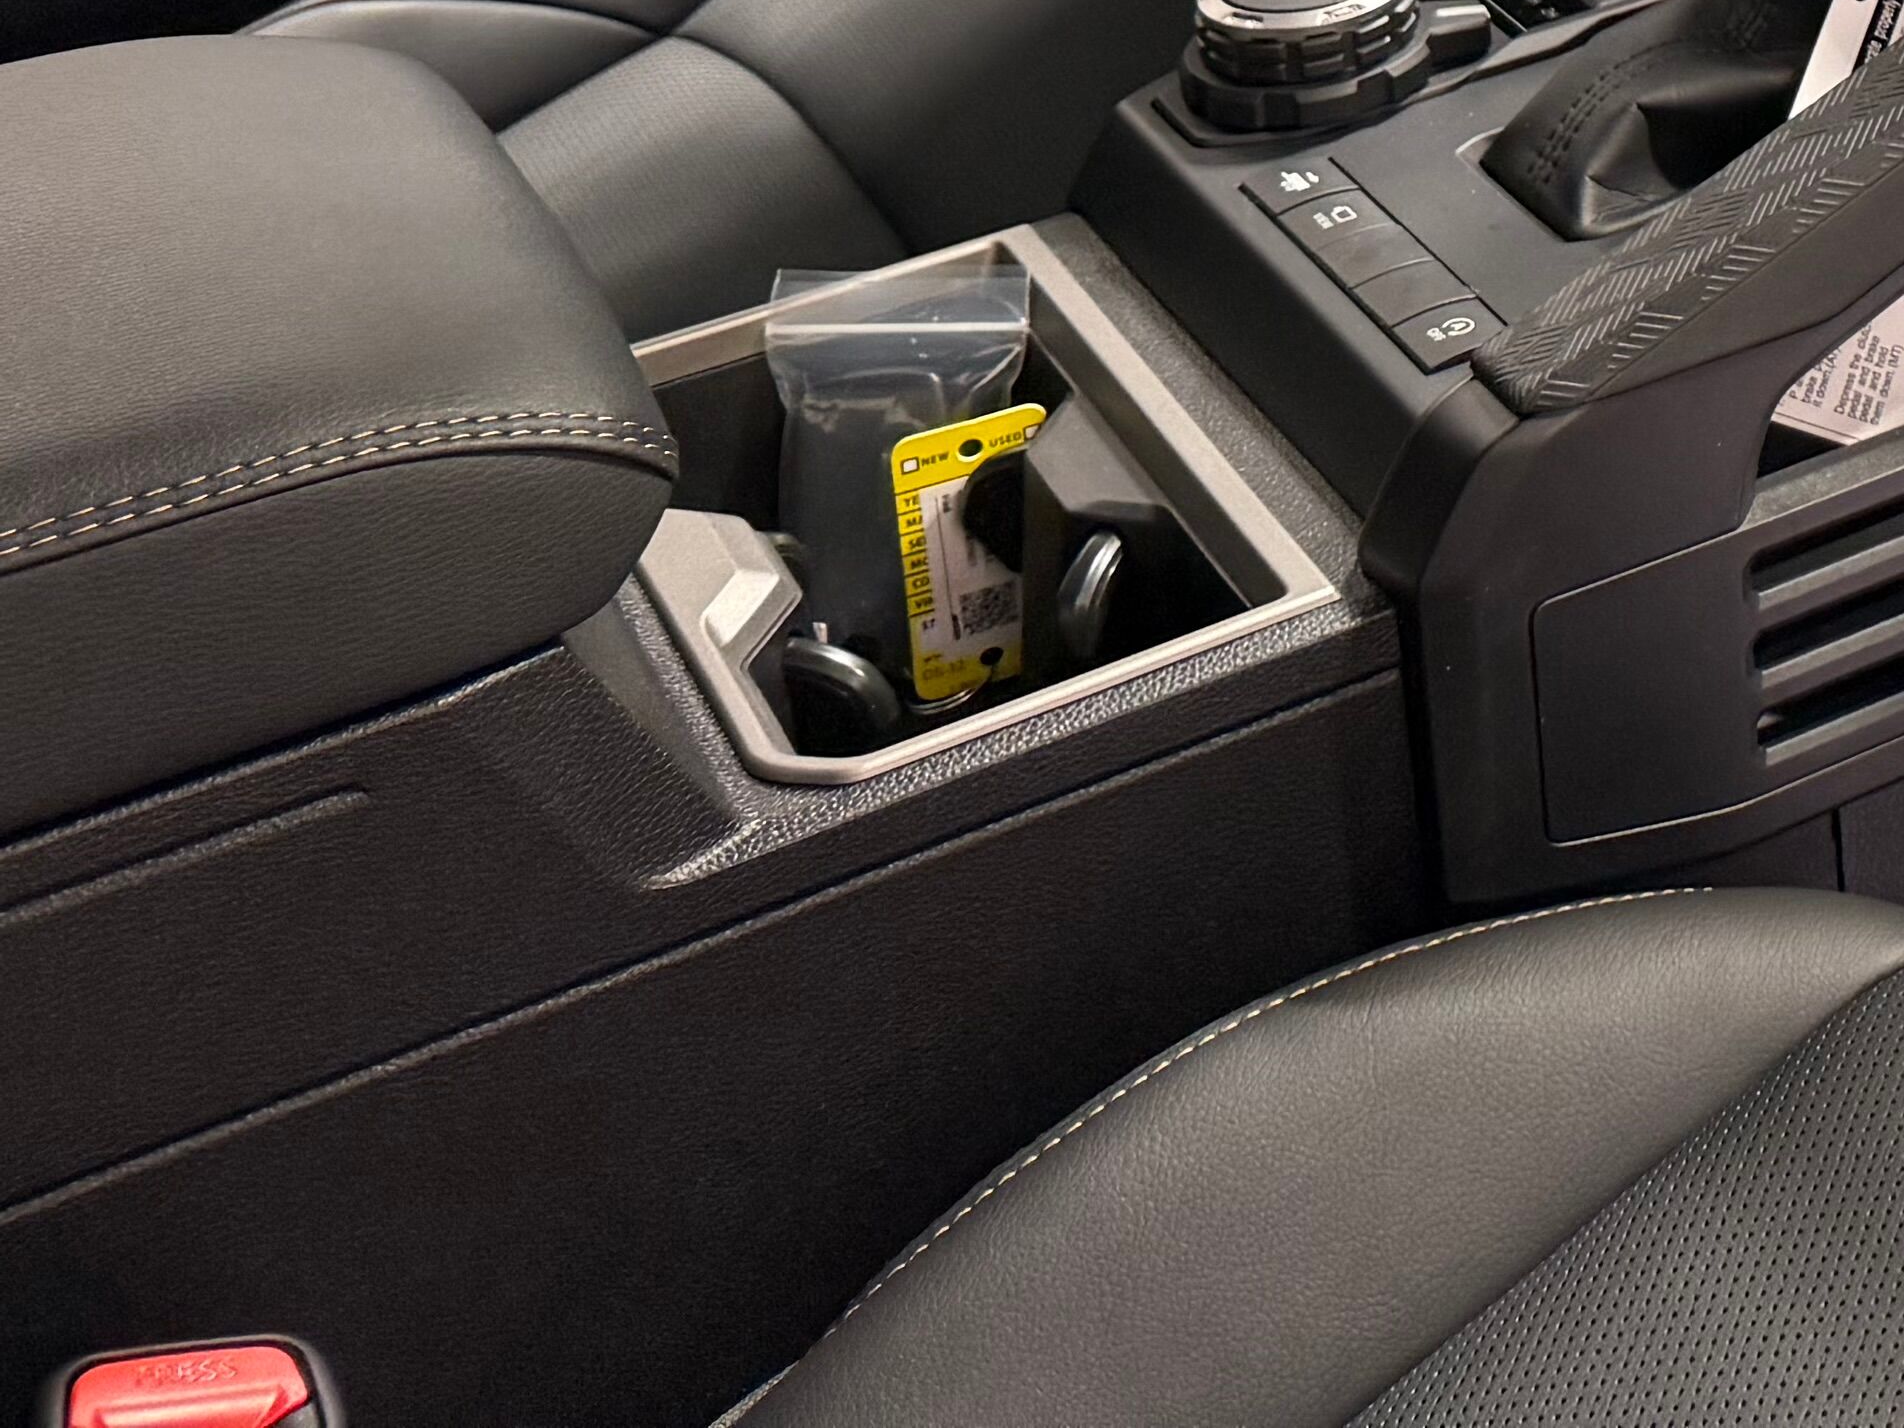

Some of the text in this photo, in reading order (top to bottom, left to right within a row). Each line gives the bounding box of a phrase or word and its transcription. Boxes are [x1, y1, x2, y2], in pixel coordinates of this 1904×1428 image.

[1862, 334, 1880, 363] brake
[1872, 345, 1889, 369] hold
[1885, 343, 1904, 368] (MT)
[1848, 352, 1862, 370] the
[1856, 365, 1870, 387] and
[1867, 370, 1881, 391] and
[919, 430, 1023, 467] NEW USED
